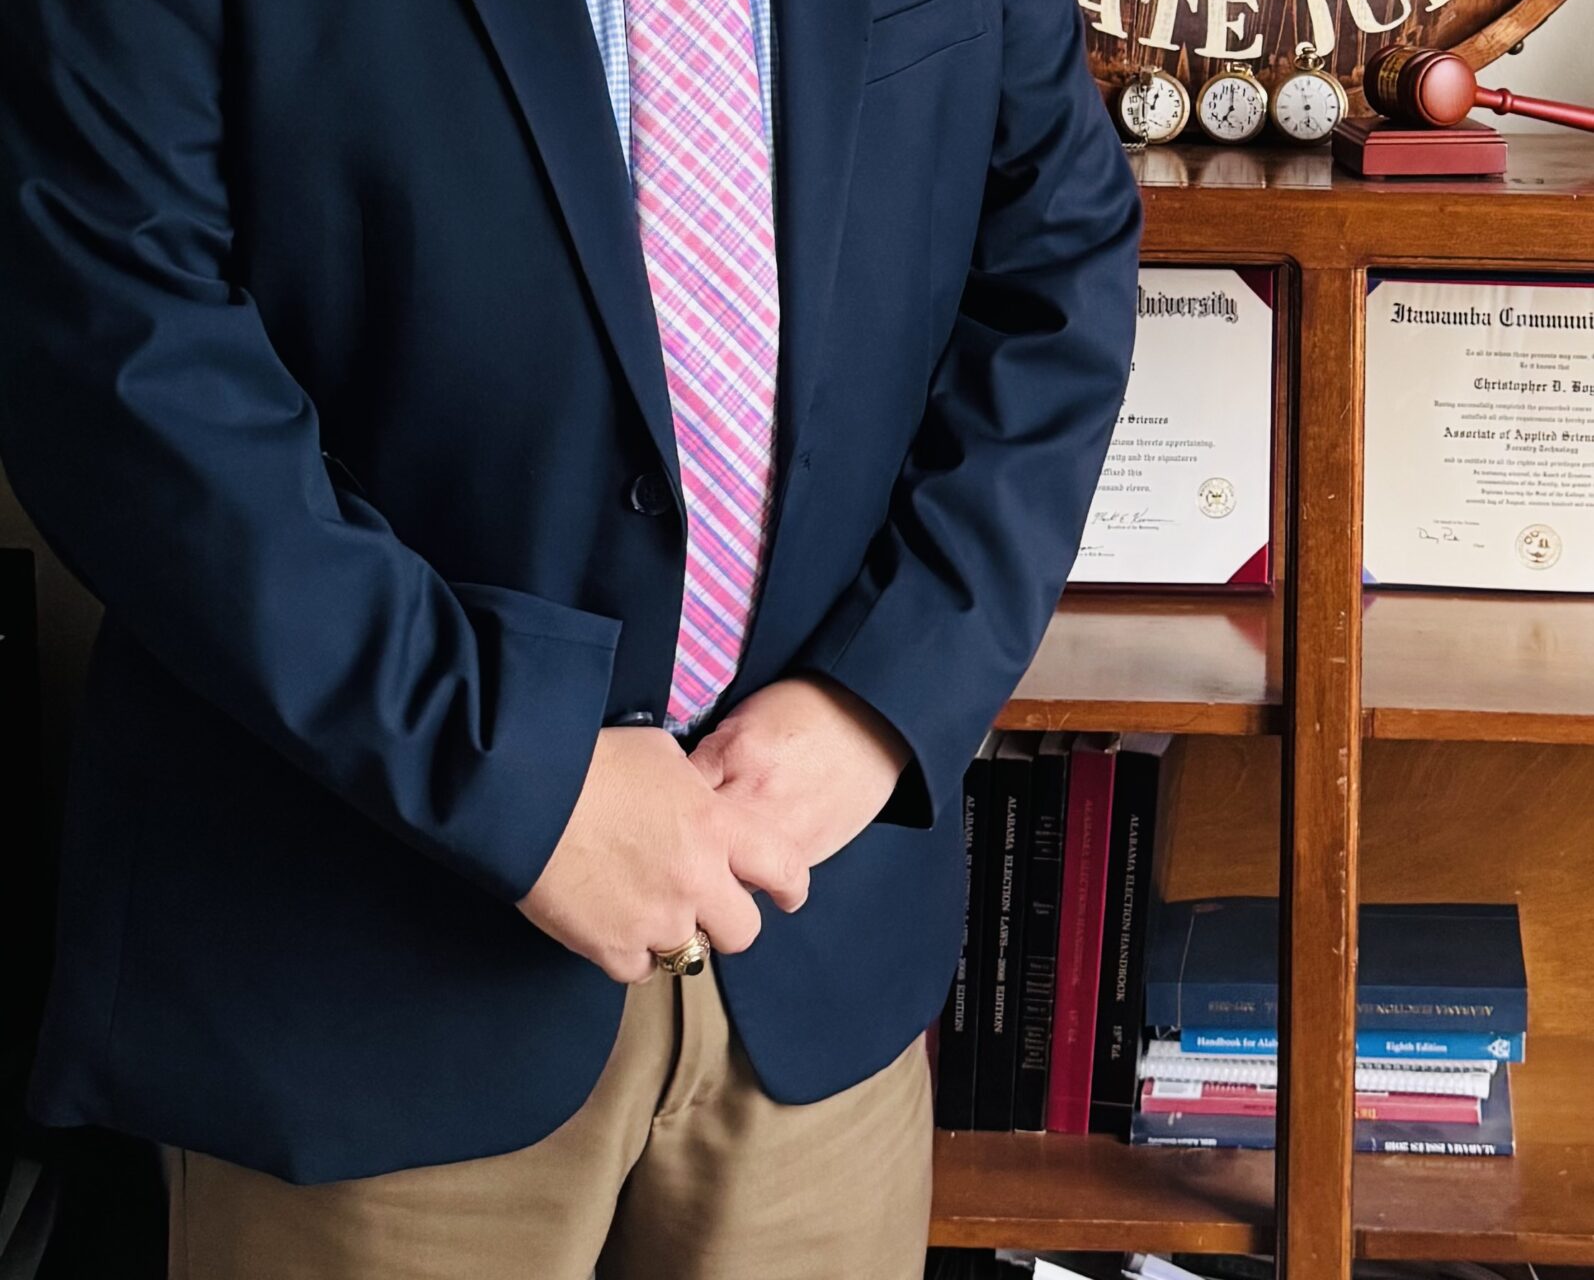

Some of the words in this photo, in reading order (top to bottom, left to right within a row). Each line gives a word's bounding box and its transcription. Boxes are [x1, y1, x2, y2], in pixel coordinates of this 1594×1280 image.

[1390, 302, 1492, 326] Itawamba
[1473, 377, 1548, 395] Christopher
[1552, 380, 1567, 393] D.
[1443, 426, 1496, 440] Associate
[1499, 429, 1511, 440] of
[1514, 429, 1557, 443] Applied
[1004, 795, 1017, 851] ALABAMA
[1126, 814, 1140, 872] ALABAMA
[1001, 854, 1014, 913] ELECTION
[1122, 874, 1136, 932] ELECTION
[1115, 933, 1131, 1003] HANDBOOK
[993, 984, 1006, 1035] EDITION
[1196, 1036, 1241, 1048] Handbook
[1242, 1037, 1256, 1048] for
[1385, 1041, 1415, 1054] Eighth
[1415, 1041, 1448, 1053] Edition
